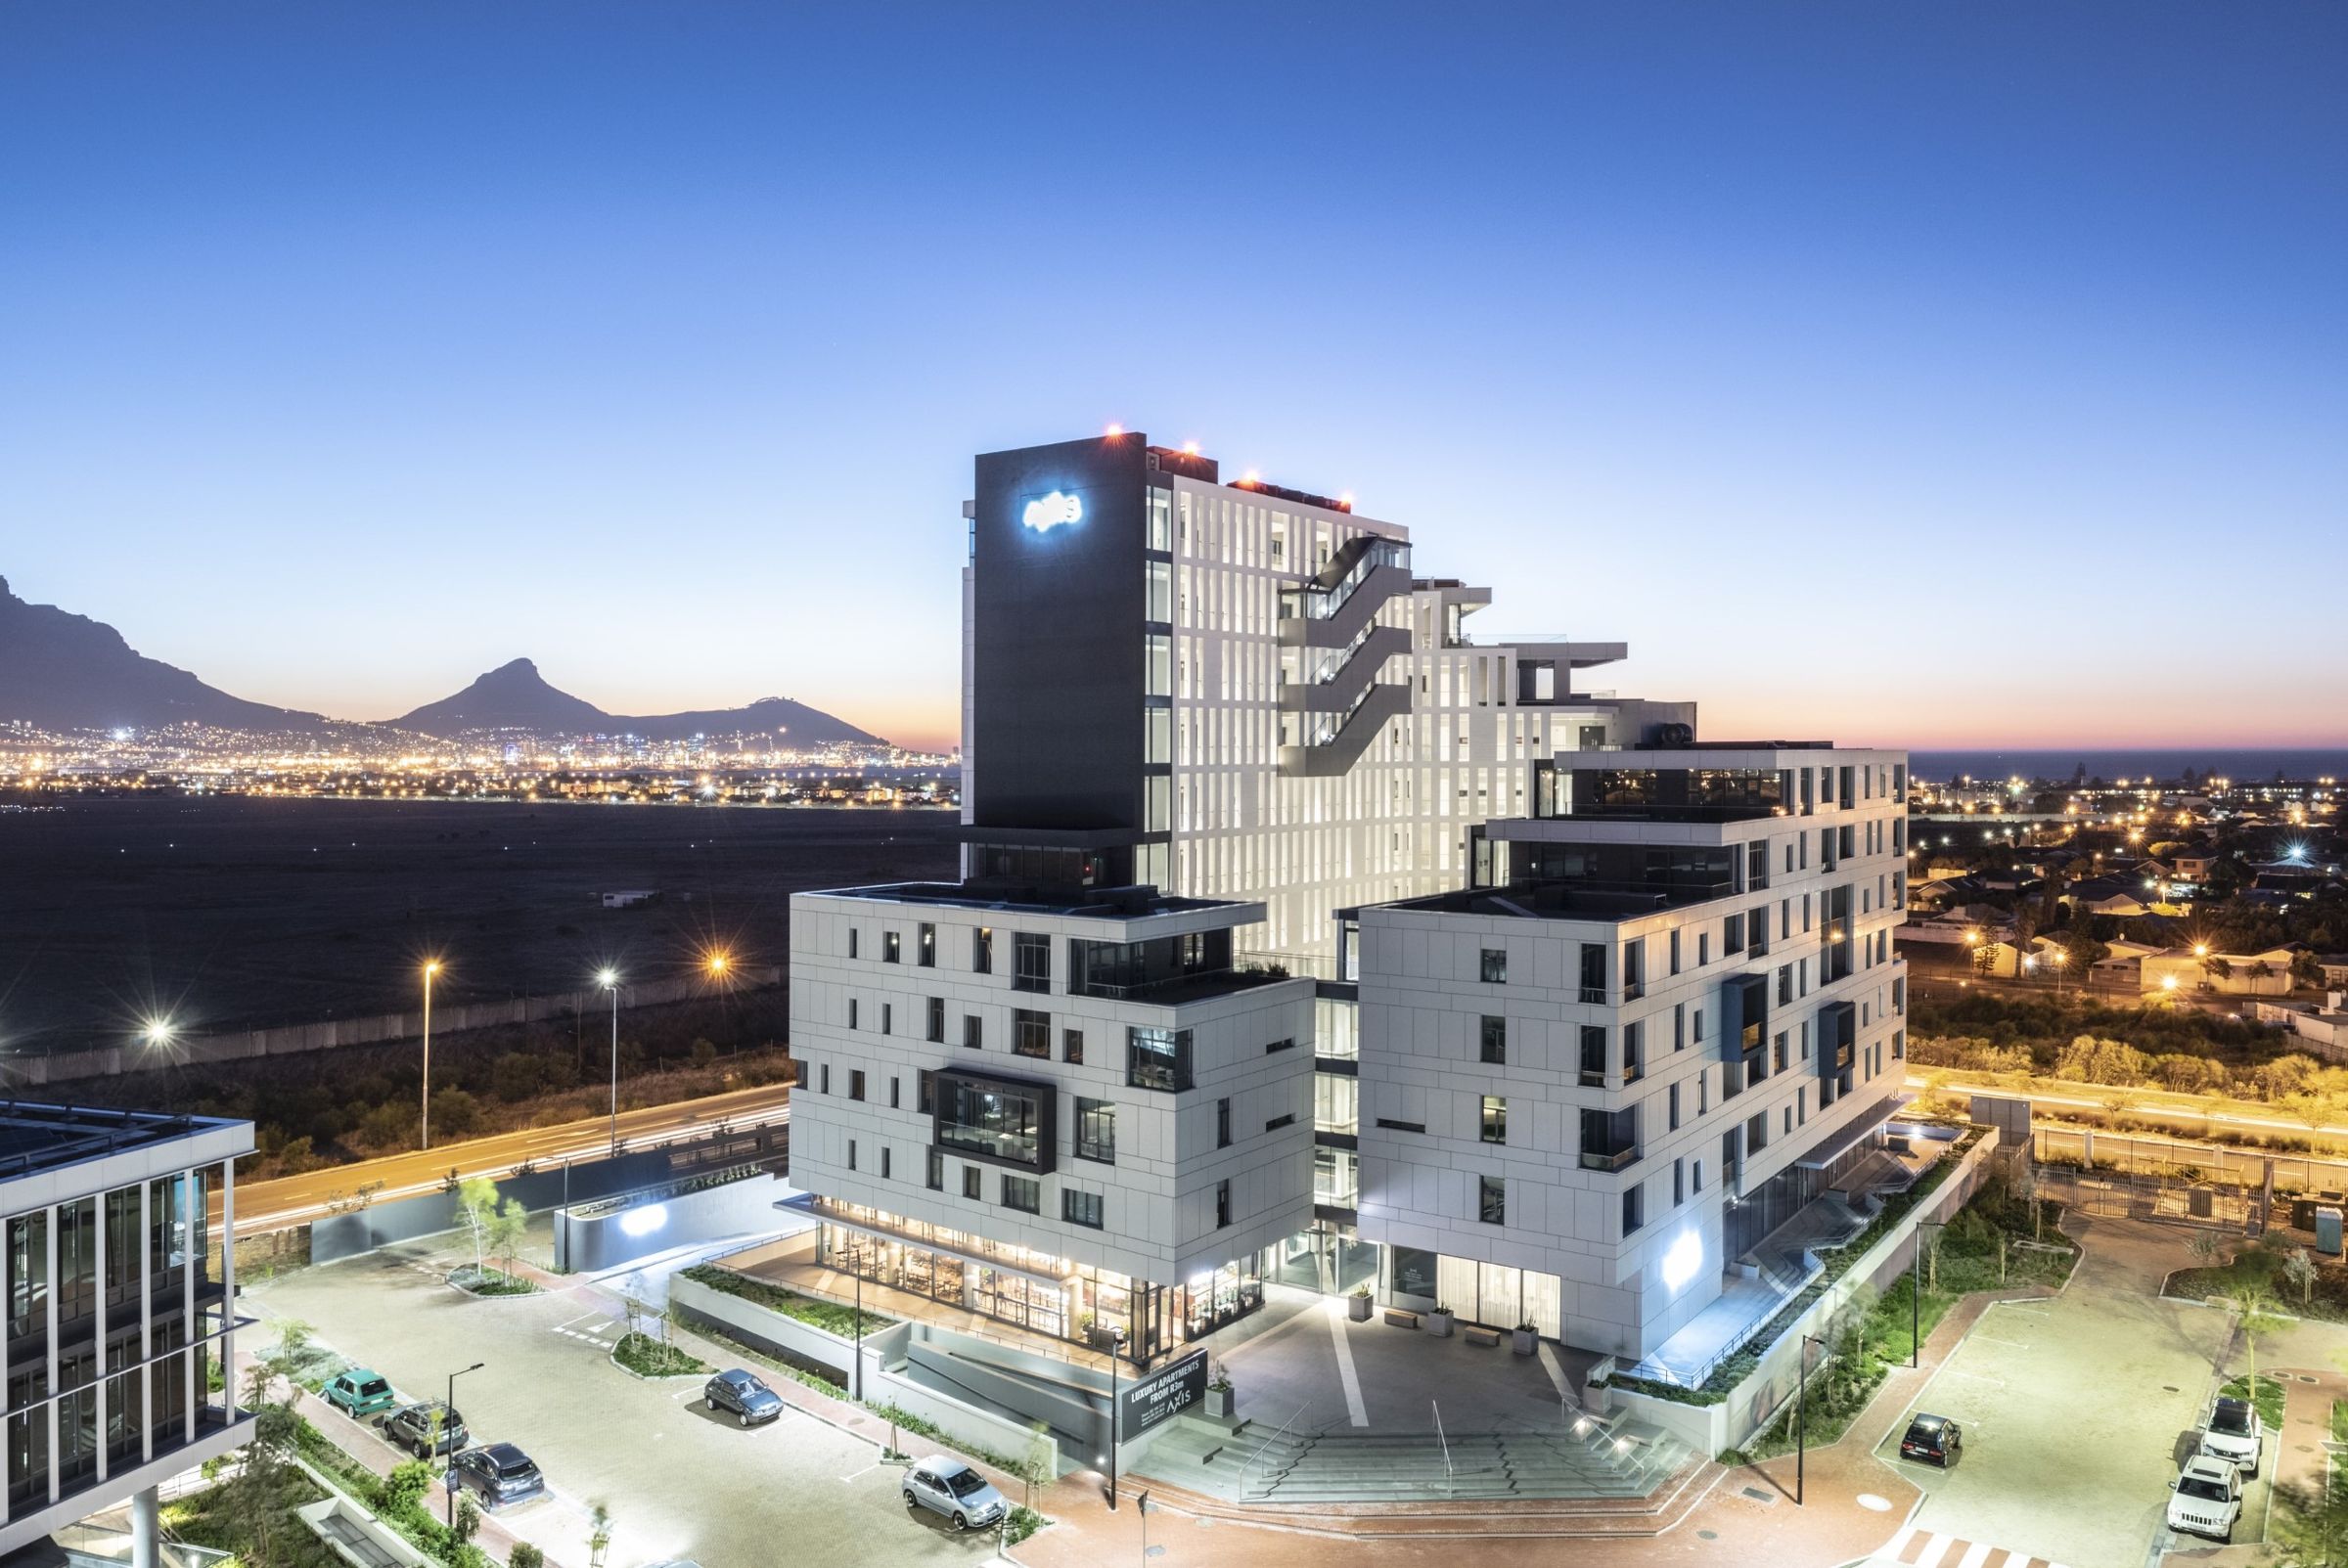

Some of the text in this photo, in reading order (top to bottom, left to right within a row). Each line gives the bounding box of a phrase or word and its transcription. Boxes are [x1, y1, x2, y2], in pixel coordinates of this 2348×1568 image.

[1131, 1360, 1199, 1403] LUXURY APARTMENTS
[1150, 1380, 1185, 1405] FROM R3m
[1166, 1389, 1191, 1413] AXIS
